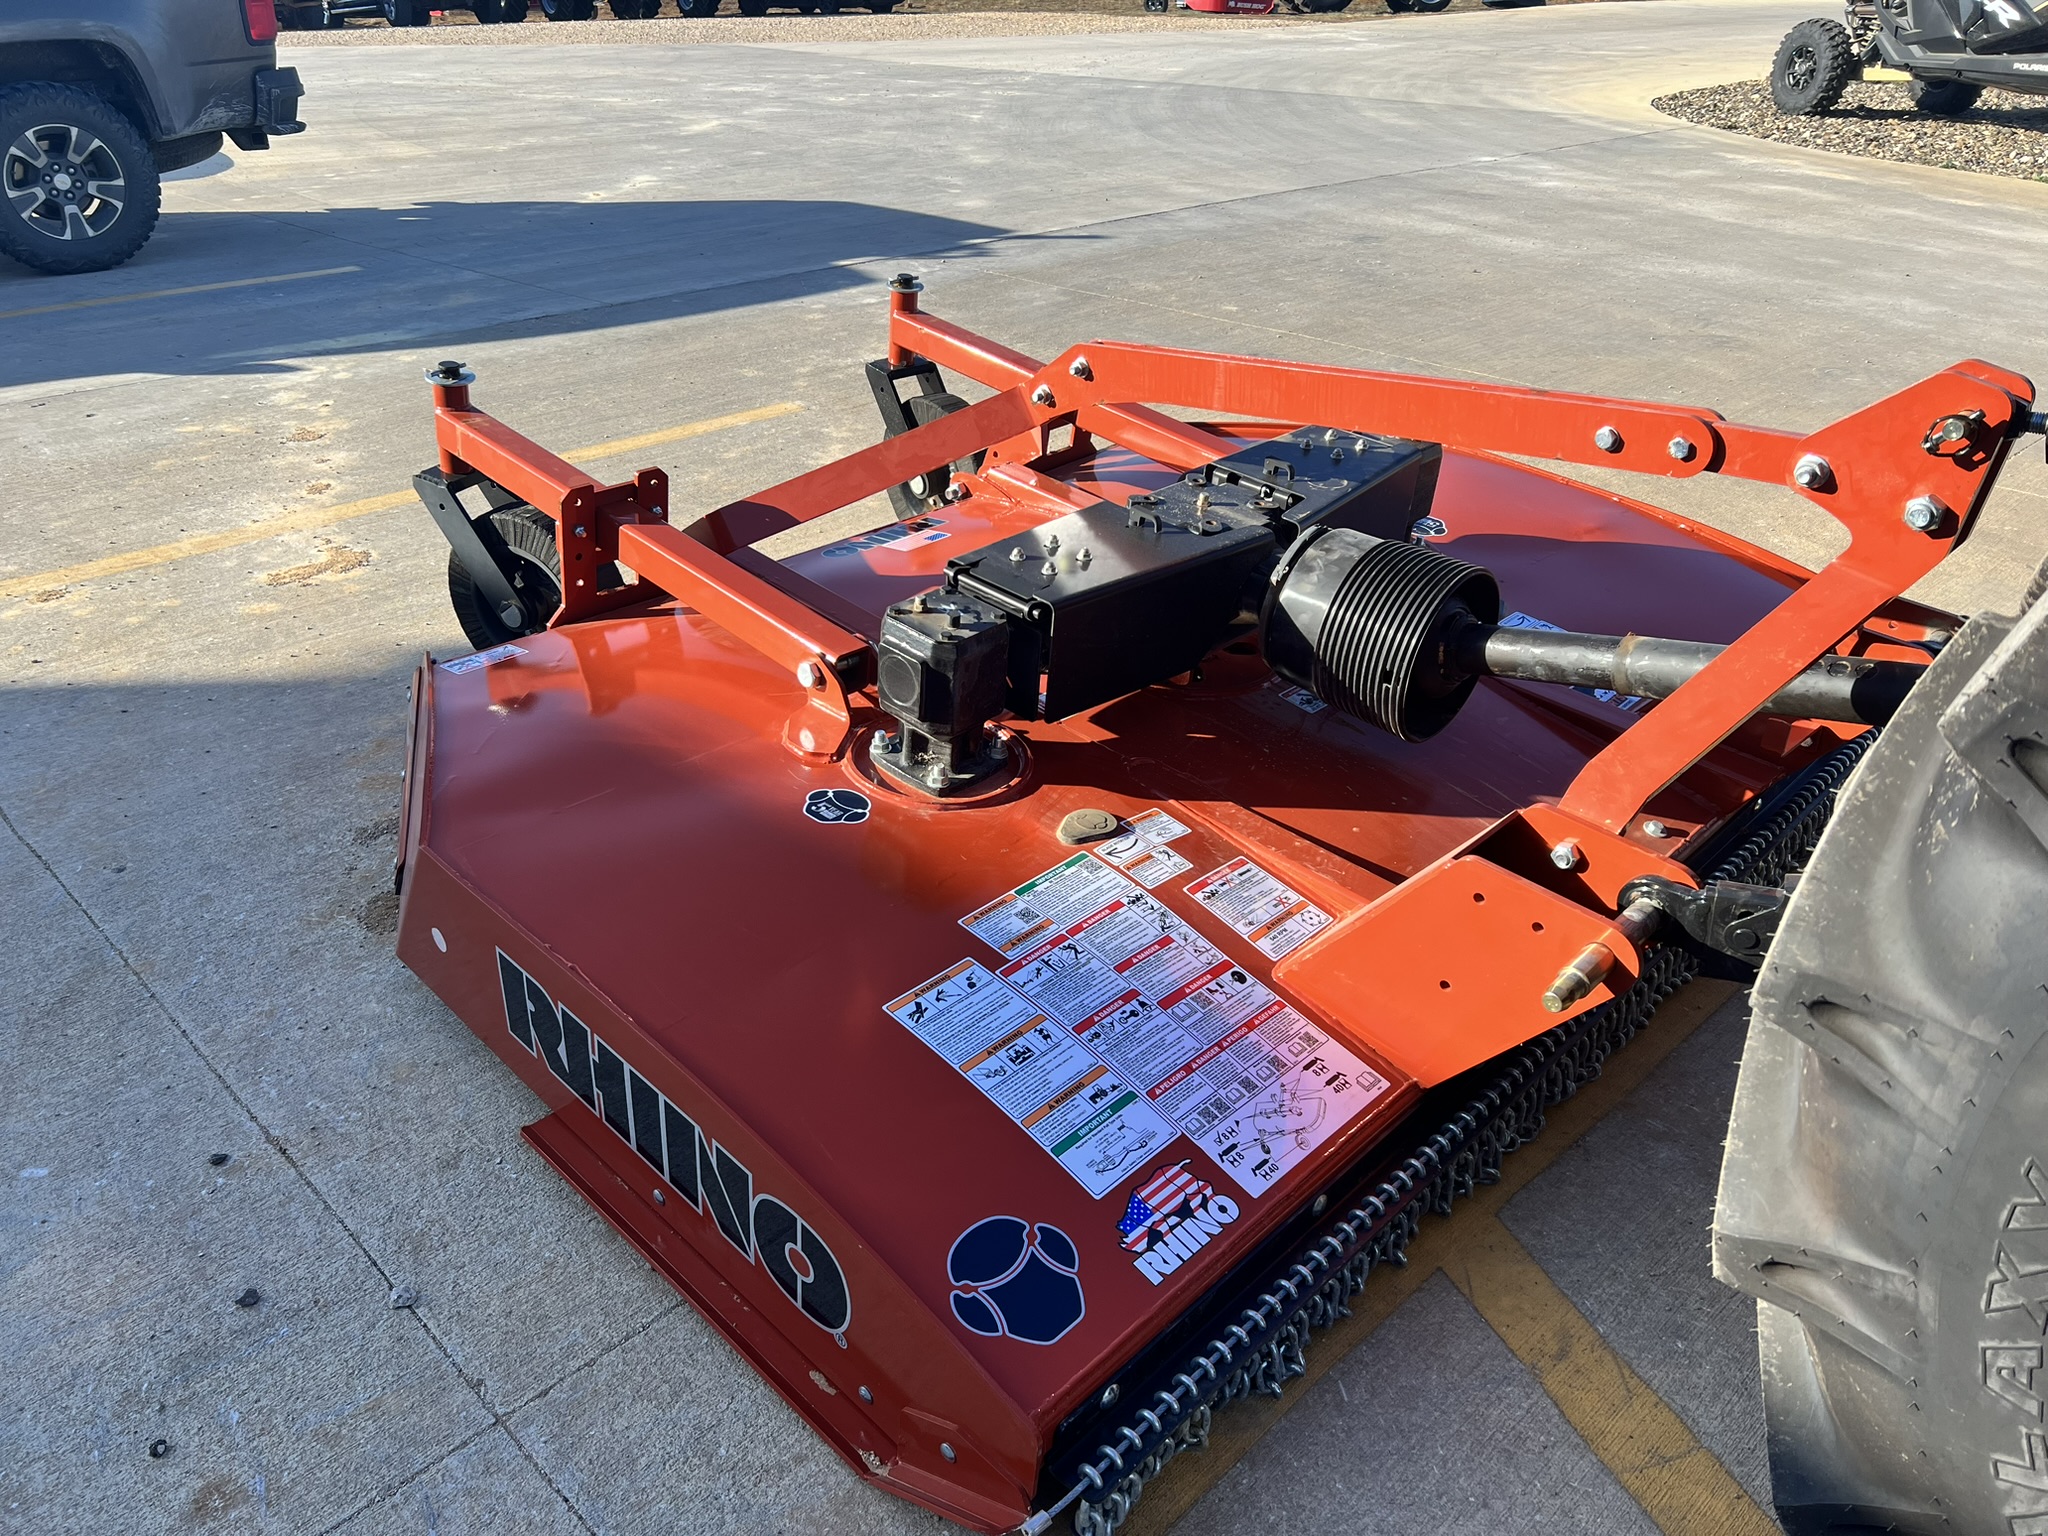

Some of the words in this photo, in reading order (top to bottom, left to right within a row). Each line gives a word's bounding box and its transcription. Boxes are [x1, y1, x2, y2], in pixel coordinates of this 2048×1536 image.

[1034, 865, 1068, 885] IMPORTANT
[979, 899, 1008, 917] WARNING
[1087, 908, 1112, 925] DANGER
[1270, 910, 1294, 928] WARNING
[1016, 924, 1045, 944] WARNING
[1027, 944, 1053, 962] DANGER
[1137, 944, 1161, 960] DANGER
[920, 974, 951, 997] WARNING
[1190, 973, 1213, 991] DANGER
[1098, 999, 1125, 1019] DANGER
[1259, 1005, 1280, 1022] GEFAHR
[992, 1029, 1024, 1052] WARNING
[1226, 1026, 1248, 1044] PERIGO
[1196, 1045, 1221, 1066] DANGER
[1159, 1070, 1187, 1092] PELIGRO
[1312, 1068, 1321, 1077] 8
[1054, 1081, 1086, 1106] WARNING
[1332, 1083, 1345, 1094] 40
[1077, 1108, 1114, 1137] IMPORTANT
[495, 945, 852, 1334] RHINO
[1221, 1131, 1230, 1141] 8
[1237, 1151, 1246, 1161] 8
[1267, 1163, 1280, 1175] 40
[1132, 1194, 1240, 1287] RHINO
